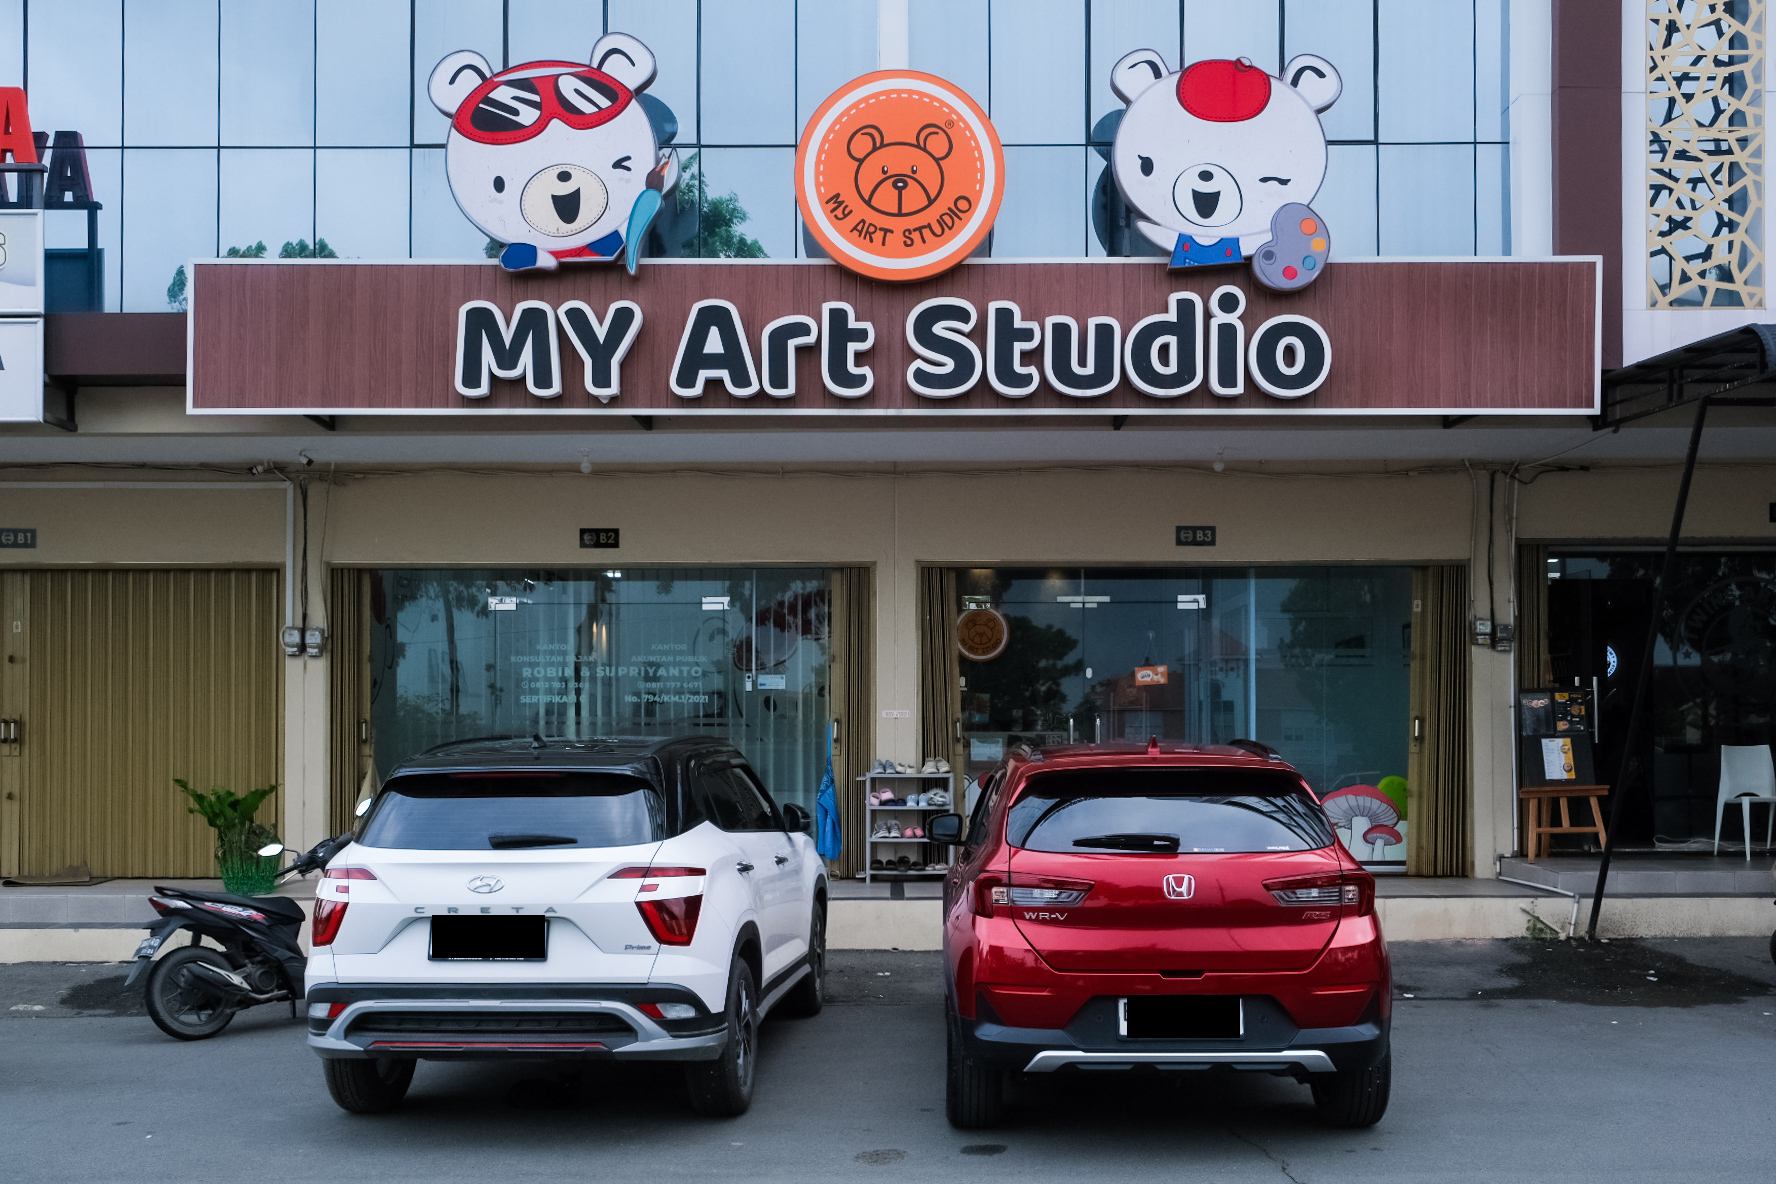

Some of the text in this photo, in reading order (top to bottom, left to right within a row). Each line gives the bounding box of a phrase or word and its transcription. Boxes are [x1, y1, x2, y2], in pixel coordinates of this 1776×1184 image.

[824, 192, 973, 248] MY ART STUDIO
[454, 284, 1332, 400] MY Art Studio
[17, 532, 32, 544] B1
[599, 532, 615, 544] B2
[1196, 529, 1212, 542] B3
[651, 643, 688, 651] KANTOR
[510, 655, 595, 663] KONSULTAN PAJAK
[522, 666, 703, 678] ROBIN & SUPRIYANTO
[520, 695, 577, 703] SERTIFIKASI
[625, 694, 641, 703] No.
[413, 906, 558, 914] CRETA
[1023, 911, 1068, 921] WR-V
[1301, 911, 1331, 920] RS
